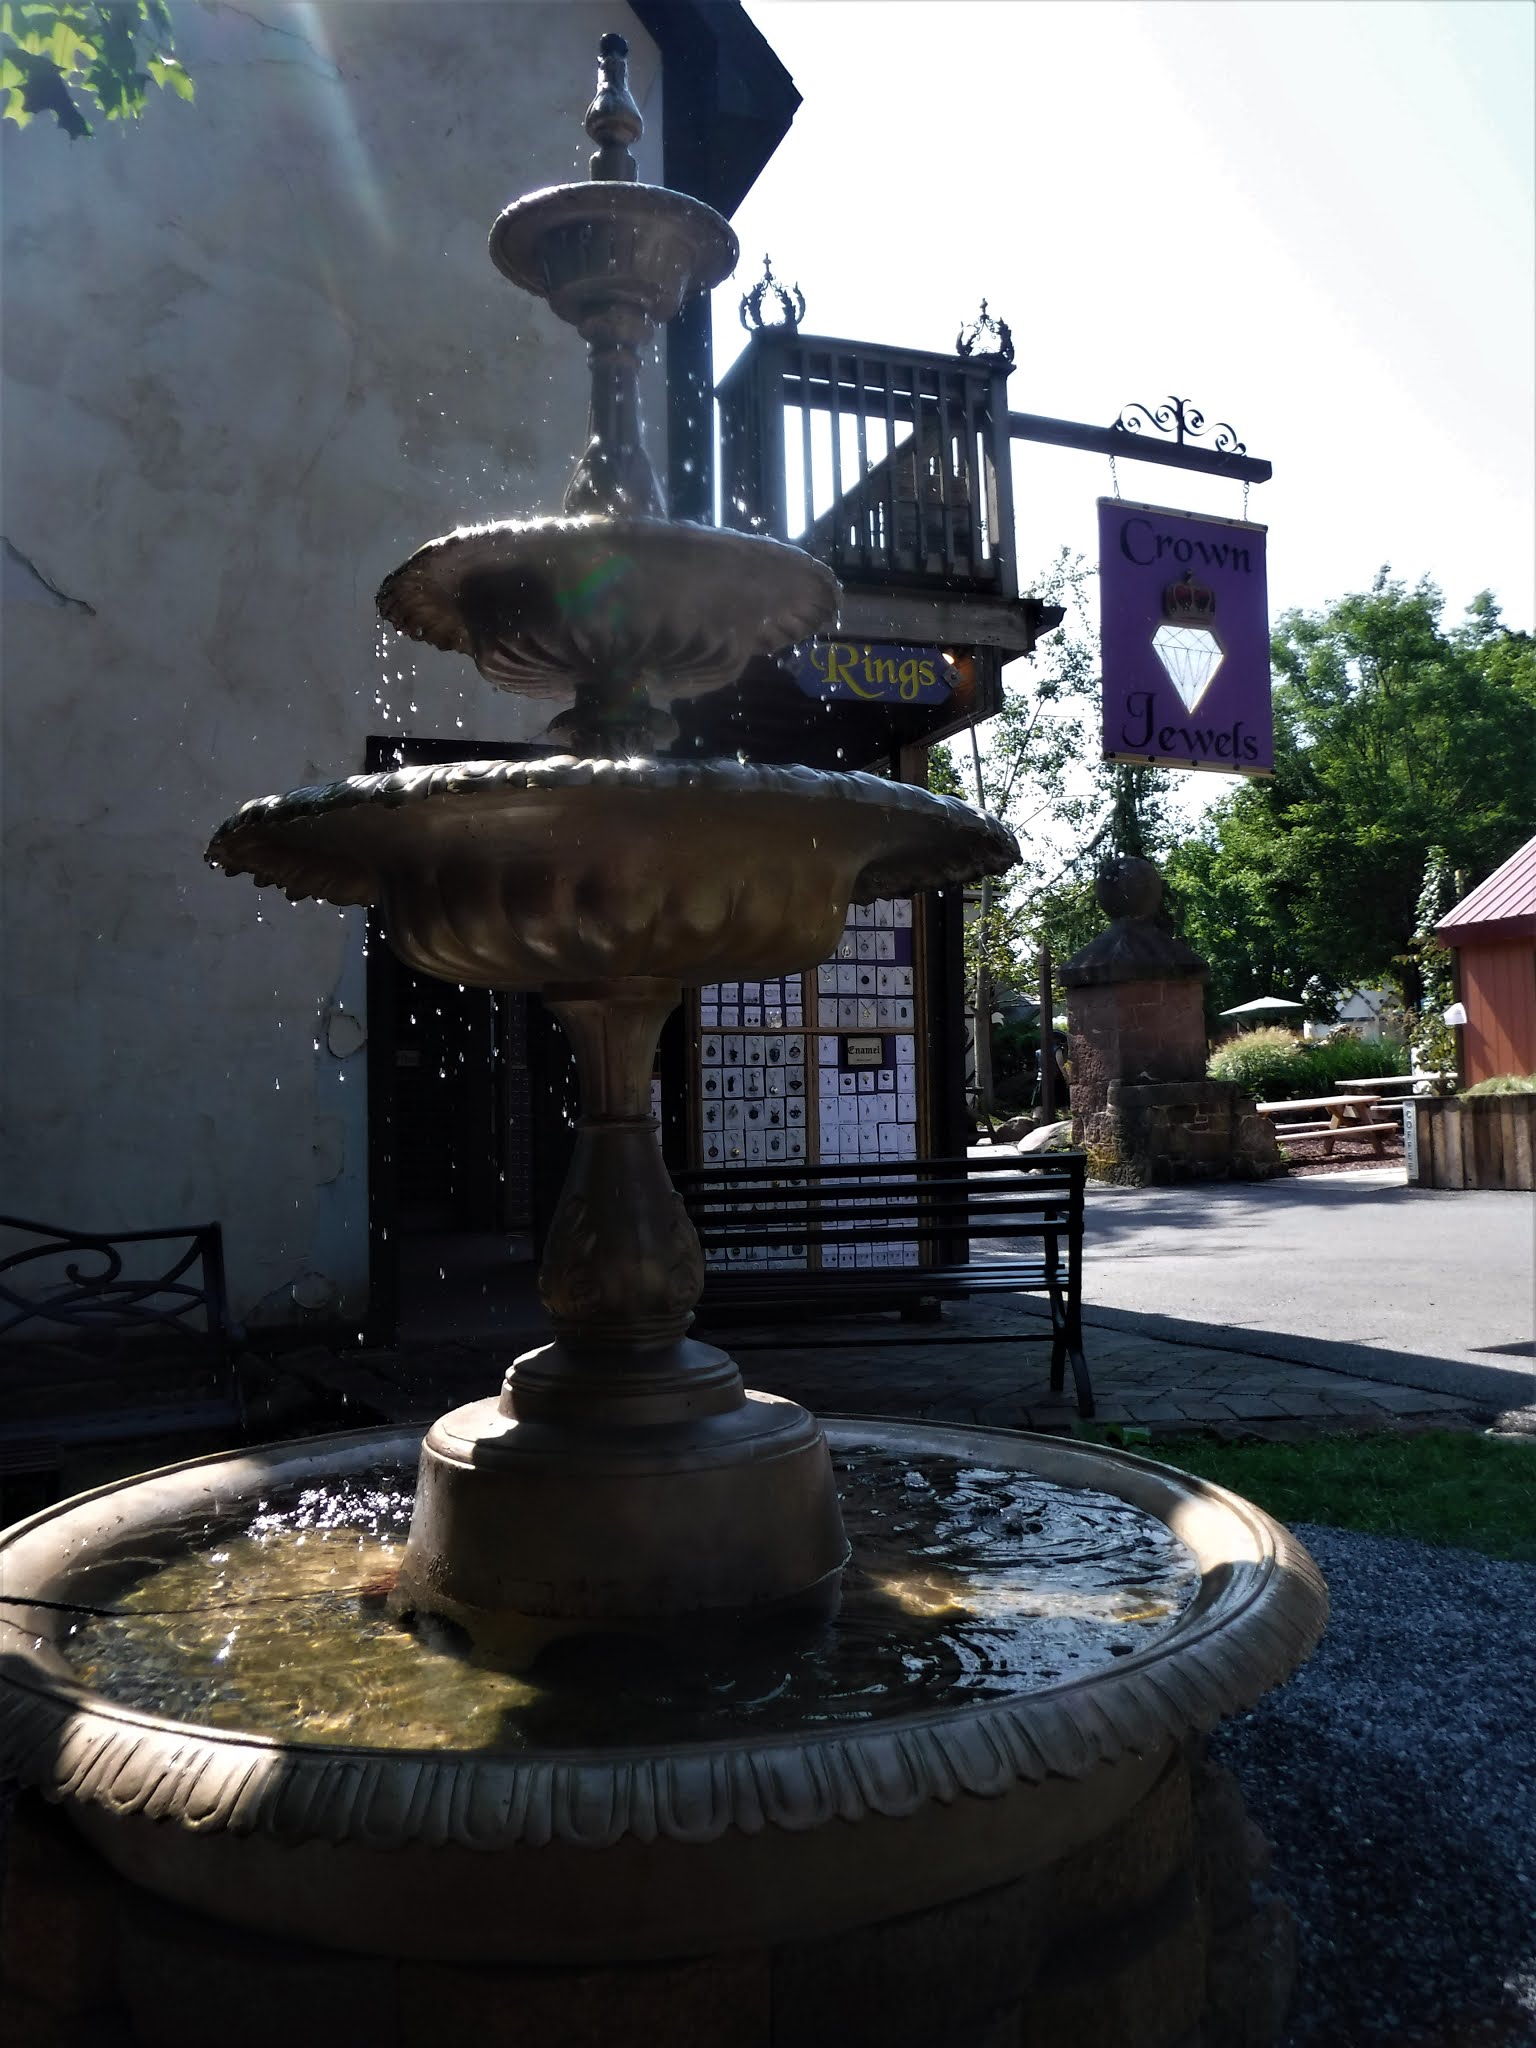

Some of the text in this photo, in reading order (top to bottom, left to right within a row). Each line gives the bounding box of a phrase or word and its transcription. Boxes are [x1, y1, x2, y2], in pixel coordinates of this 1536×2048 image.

[1119, 517, 1252, 574] Crown
[809, 642, 936, 700] Rings
[1120, 691, 1259, 761] Jewels
[848, 1045, 880, 1055] Enamel
[1405, 1109, 1414, 1171] COFFEE
